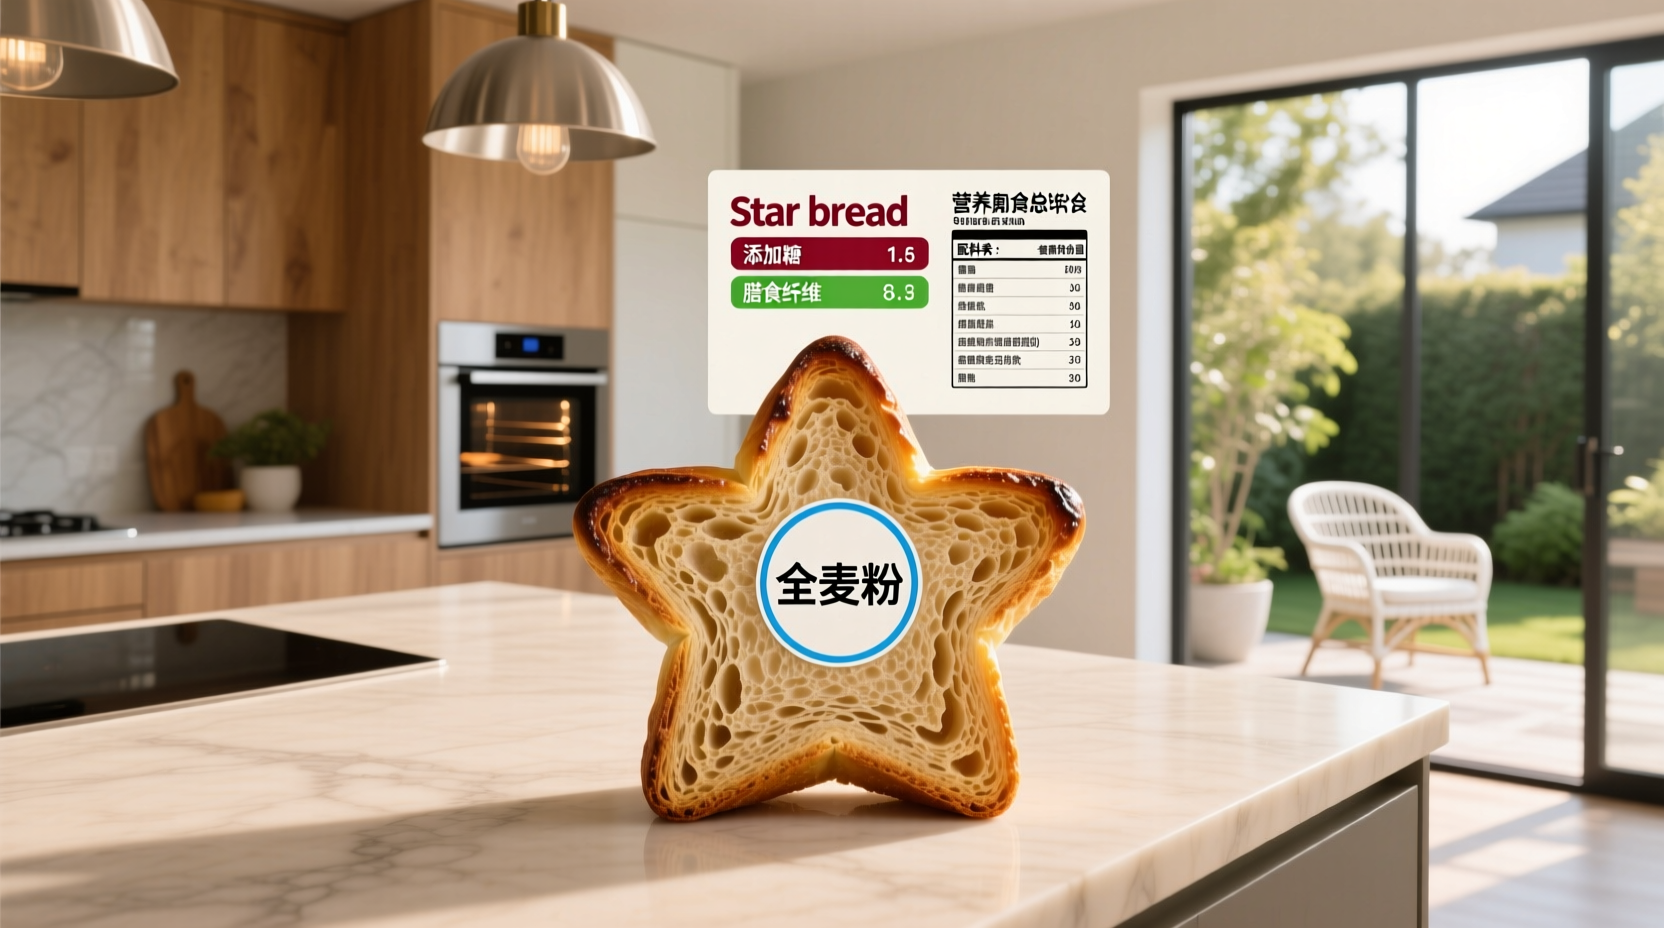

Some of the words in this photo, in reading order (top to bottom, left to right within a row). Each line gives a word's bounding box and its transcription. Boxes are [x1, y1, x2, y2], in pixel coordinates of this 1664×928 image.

[730, 196, 800, 227] Star
[809, 195, 908, 227] bread
[744, 244, 802, 266] 添加糖
[1068, 356, 1081, 365] 30
[1068, 374, 1081, 383] 30
[776, 562, 903, 606] 全麦粉
